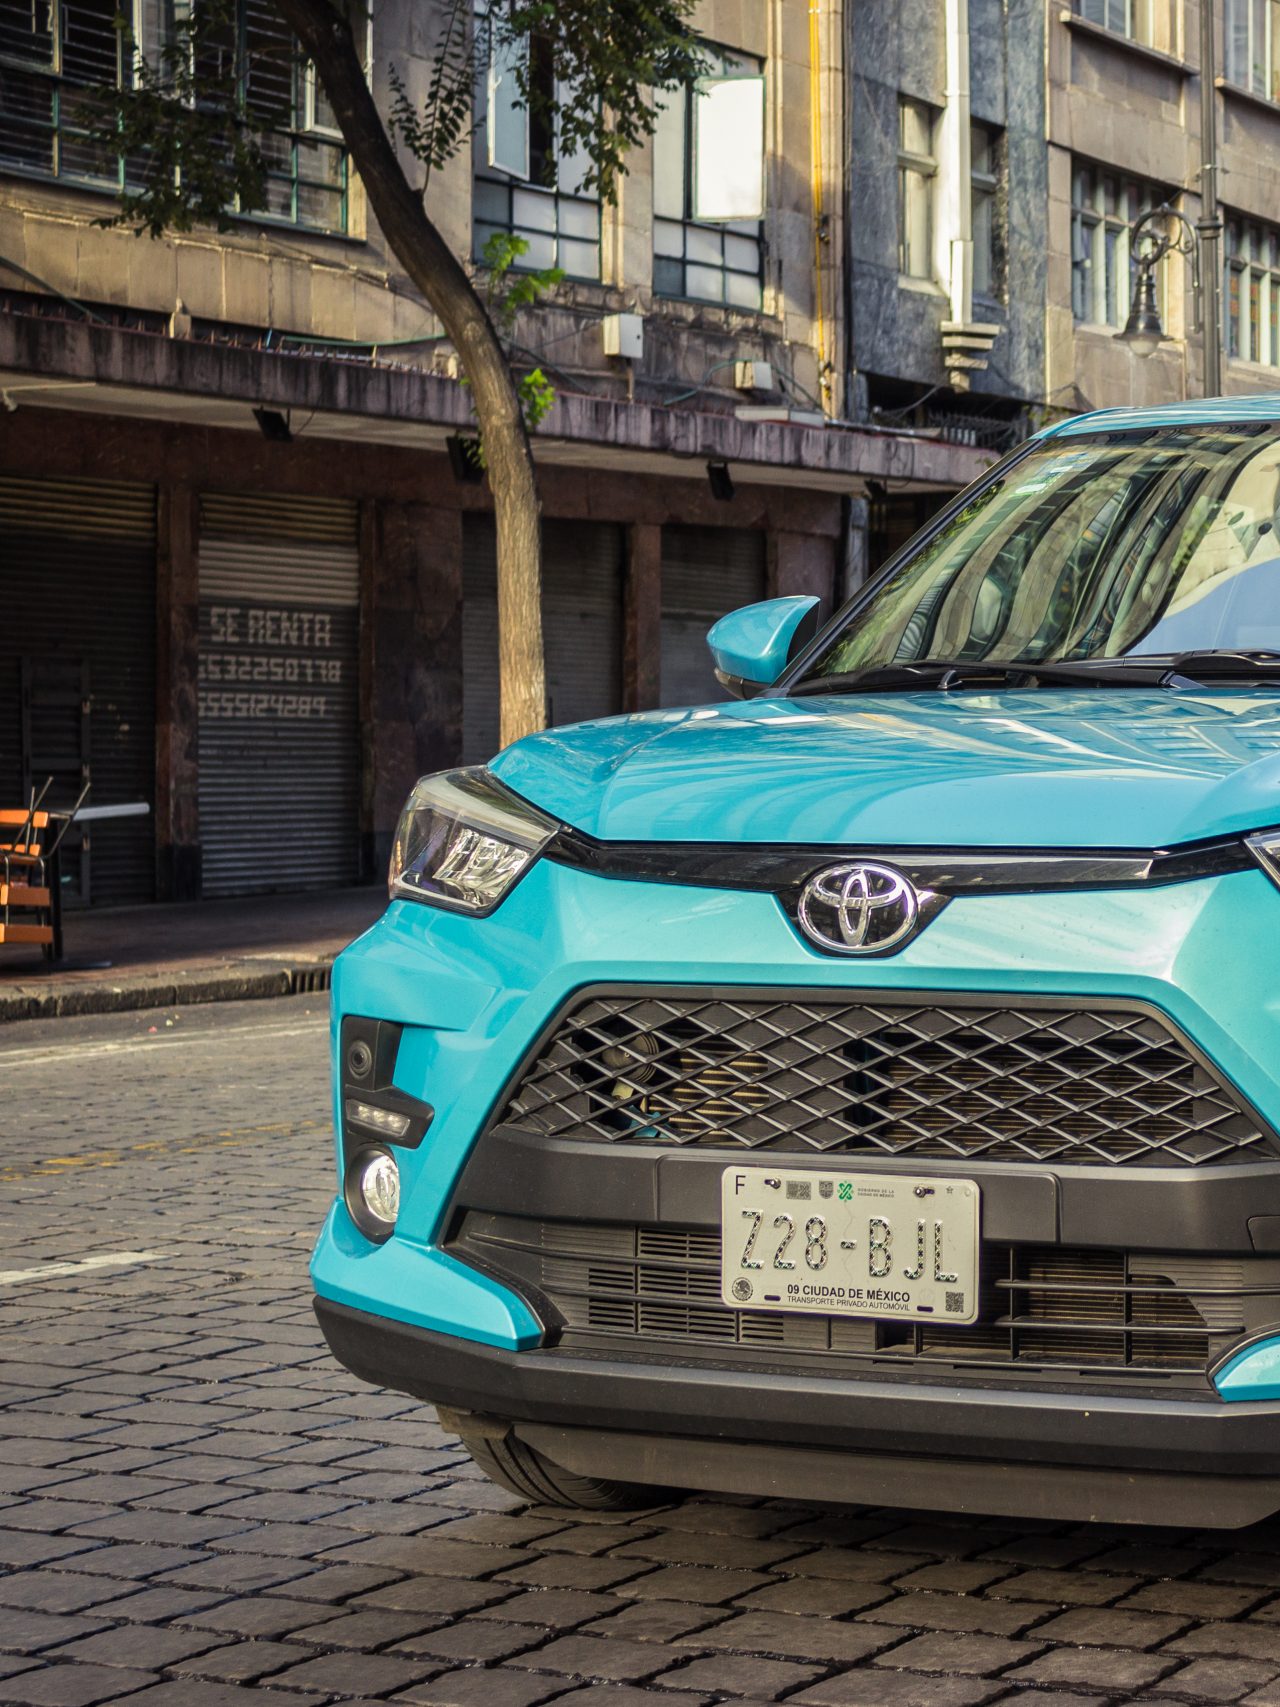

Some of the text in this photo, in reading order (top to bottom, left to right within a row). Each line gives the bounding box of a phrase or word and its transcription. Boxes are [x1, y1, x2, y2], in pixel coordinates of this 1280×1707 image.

[211, 608, 331, 646] SE RENTA
[735, 1174, 746, 1195] F
[740, 1209, 958, 1282] Z28-BJL
[787, 1284, 910, 1302] 09 CIUDAD DE MÉXICO
[787, 1296, 911, 1312] TRANSPORTE PRIVADO AUTOMÓVIL
